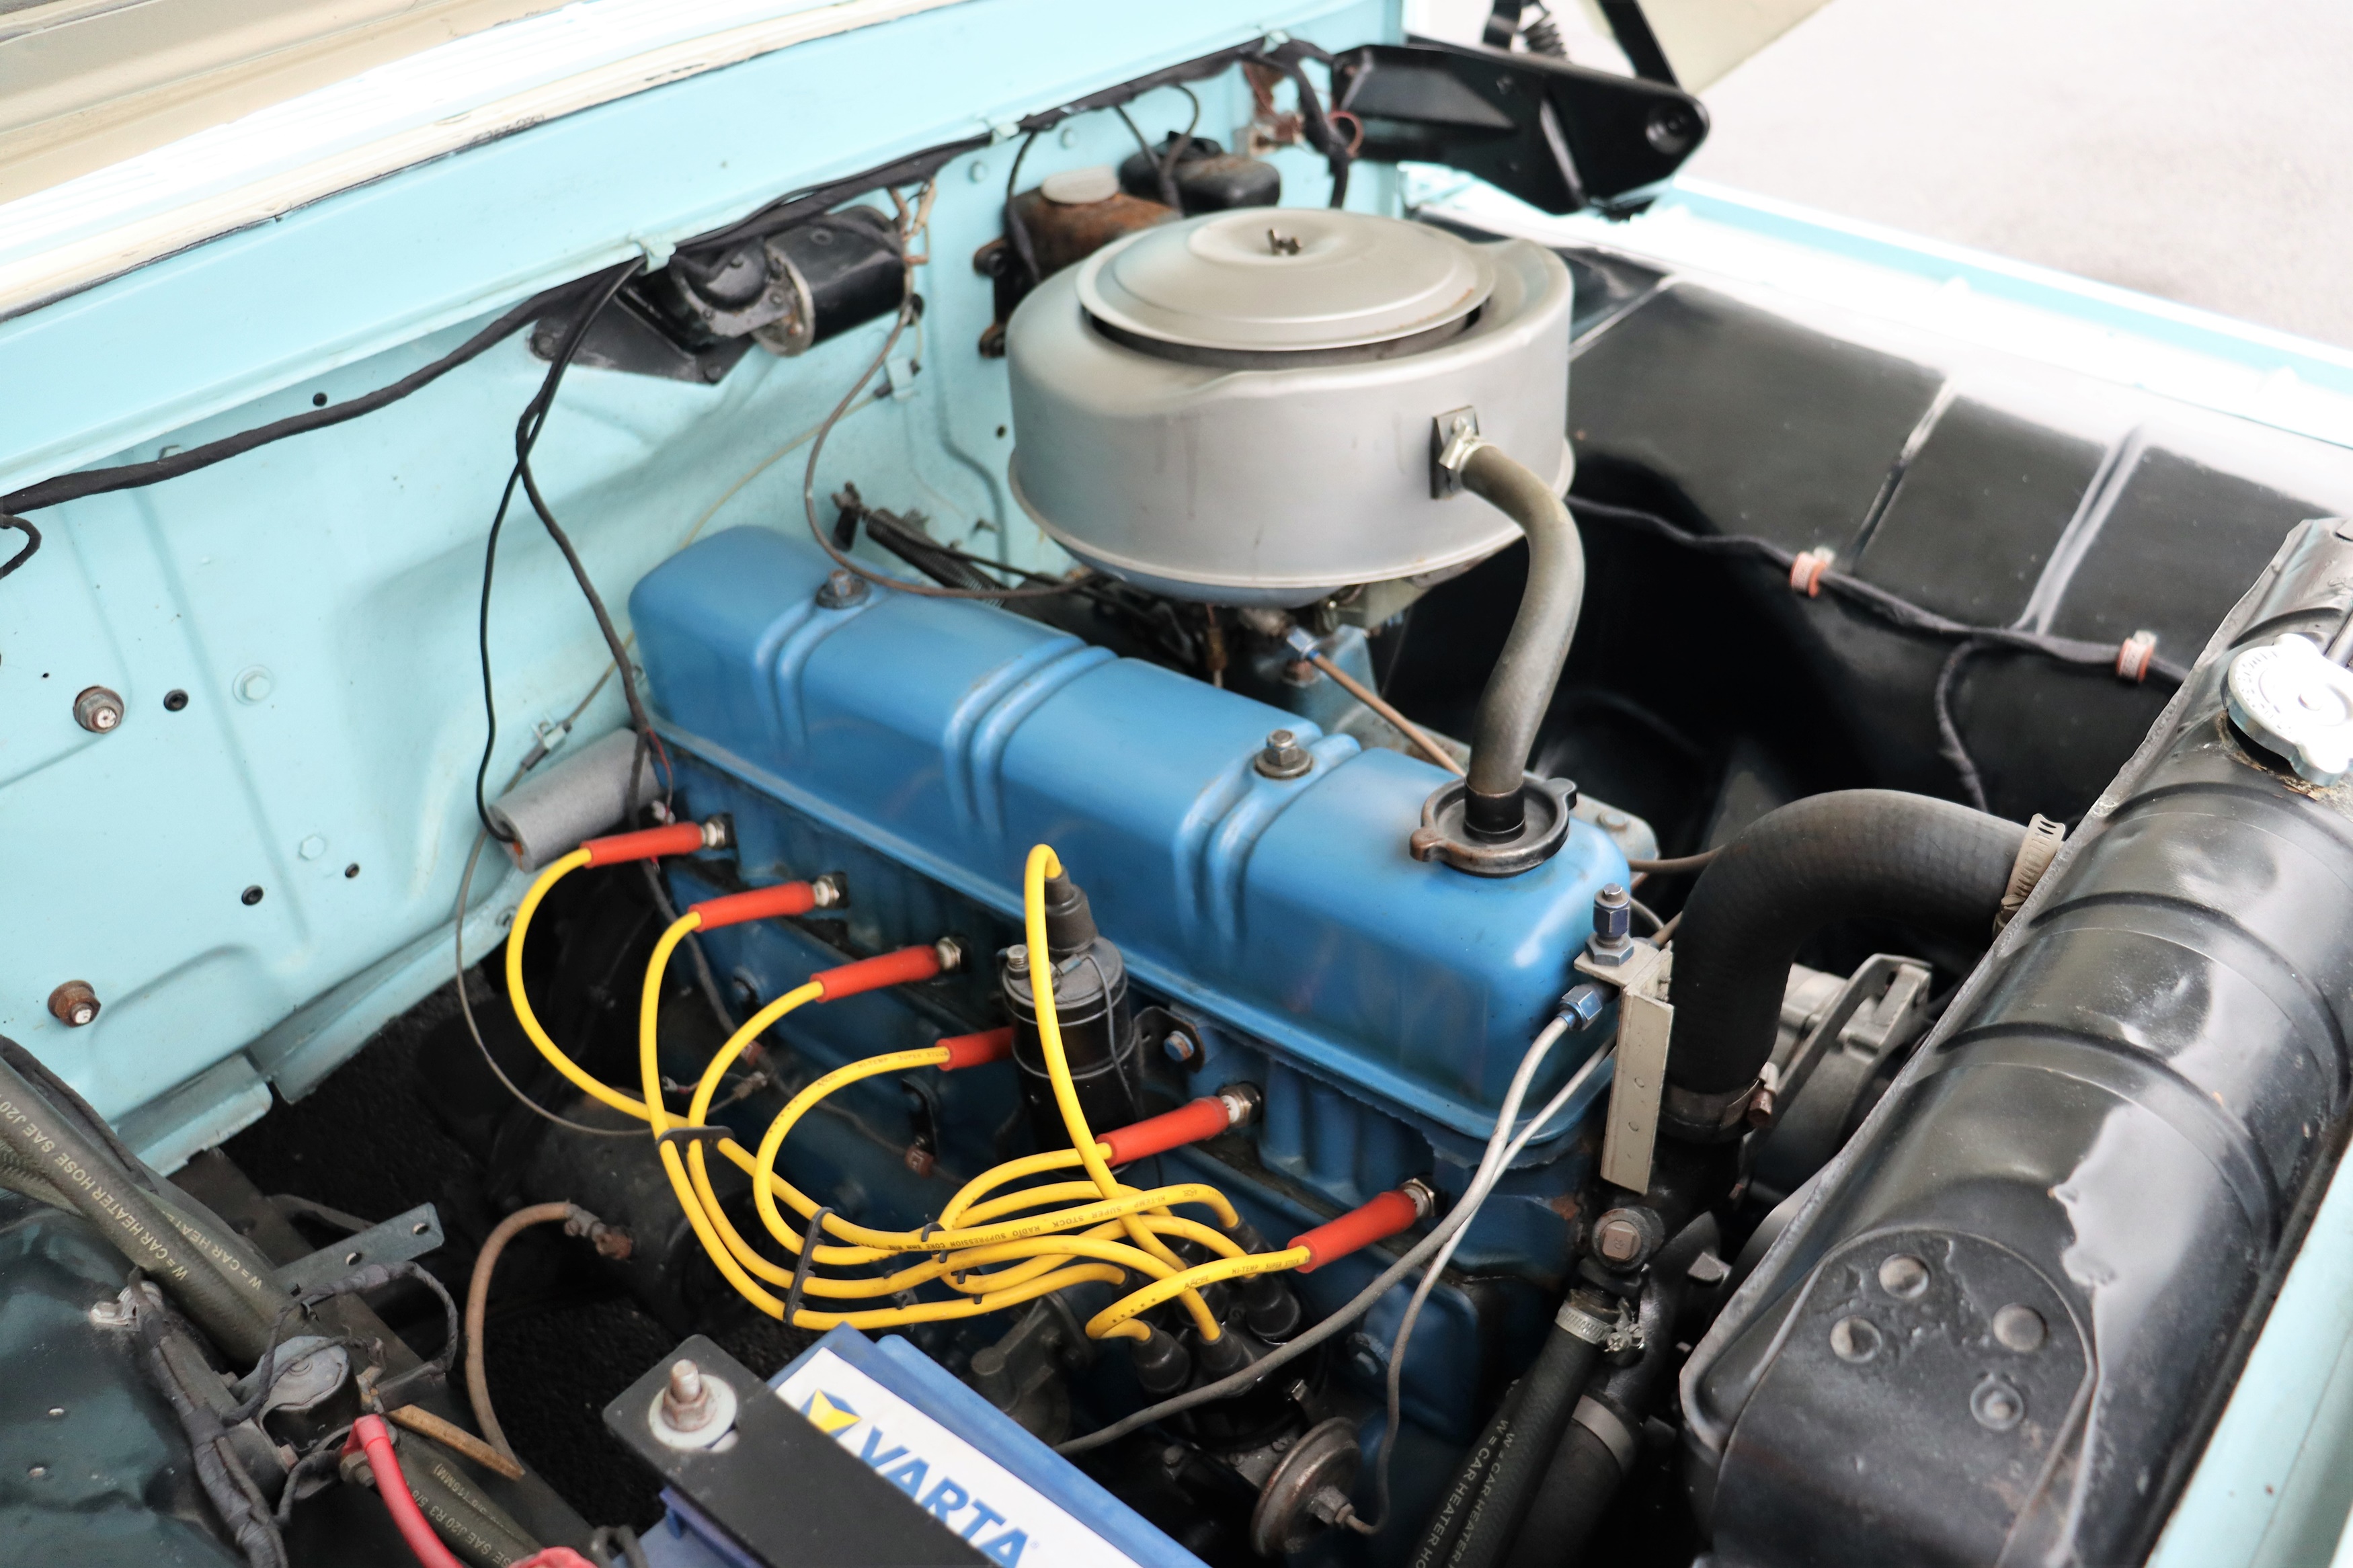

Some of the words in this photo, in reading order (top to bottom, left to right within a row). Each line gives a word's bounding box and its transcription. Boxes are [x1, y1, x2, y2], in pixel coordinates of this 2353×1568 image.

[0, 1102, 27, 1124] J20
[22, 1123, 55, 1153] SAE
[54, 1153, 95, 1190] HOSE
[91, 1186, 144, 1235] HEATER
[1091, 1206, 1122, 1219] SUPER
[1133, 1195, 1166, 1208] HI-TEMP
[1012, 1225, 1041, 1237] RADIO
[1052, 1215, 1084, 1228] STOCK
[141, 1231, 168, 1259] CAR
[926, 1242, 945, 1250] CORE
[949, 1233, 1006, 1248] SUPPRESSION
[212, 1244, 240, 1270] CAR
[1232, 1264, 1259, 1275] HI-TEMP
[1265, 1262, 1282, 1270] SUPER
[172, 1266, 188, 1280] W
[248, 1276, 262, 1290] W
[1464, 1448, 1490, 1481] CAR
[1481, 1462, 1501, 1497] CAR
[860, 1424, 1029, 1568] VARTA
[1427, 1483, 1468, 1546] HEATER
[445, 1517, 468, 1536] J20
[1451, 1499, 1486, 1562] HEATER
[465, 1531, 491, 1555] SAE
